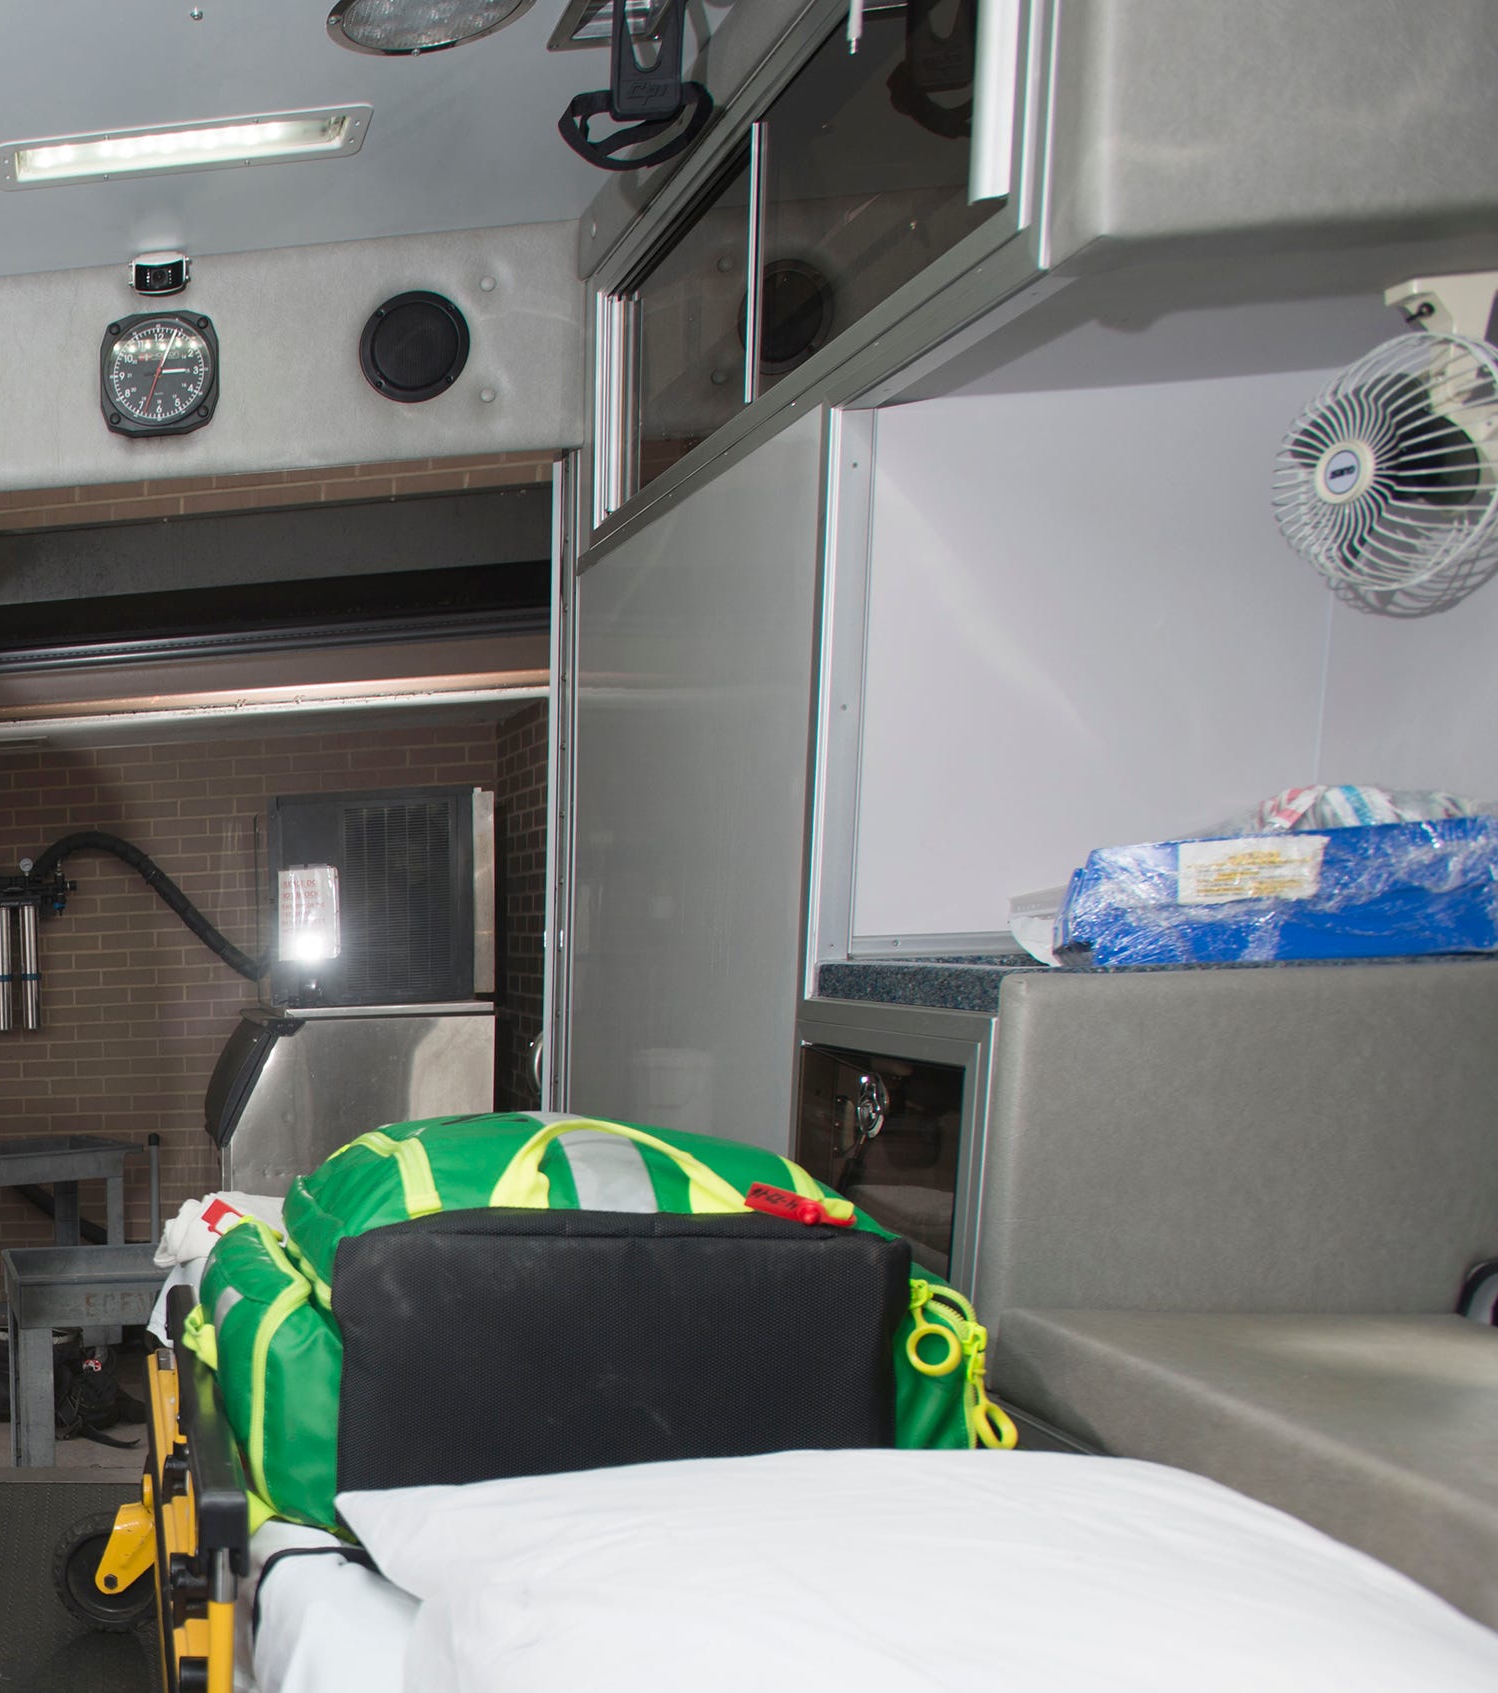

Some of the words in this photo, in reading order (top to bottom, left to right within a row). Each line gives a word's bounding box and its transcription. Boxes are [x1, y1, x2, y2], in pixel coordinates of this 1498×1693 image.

[154, 333, 164, 341] 12
[188, 349, 194, 358] 2
[124, 354, 133, 363] 10
[193, 366, 199, 375] 3
[119, 371, 125, 380] 9
[187, 383, 194, 392] 4
[125, 388, 130, 398] 8
[138, 401, 144, 410] 7
[156, 405, 162, 414] 6
